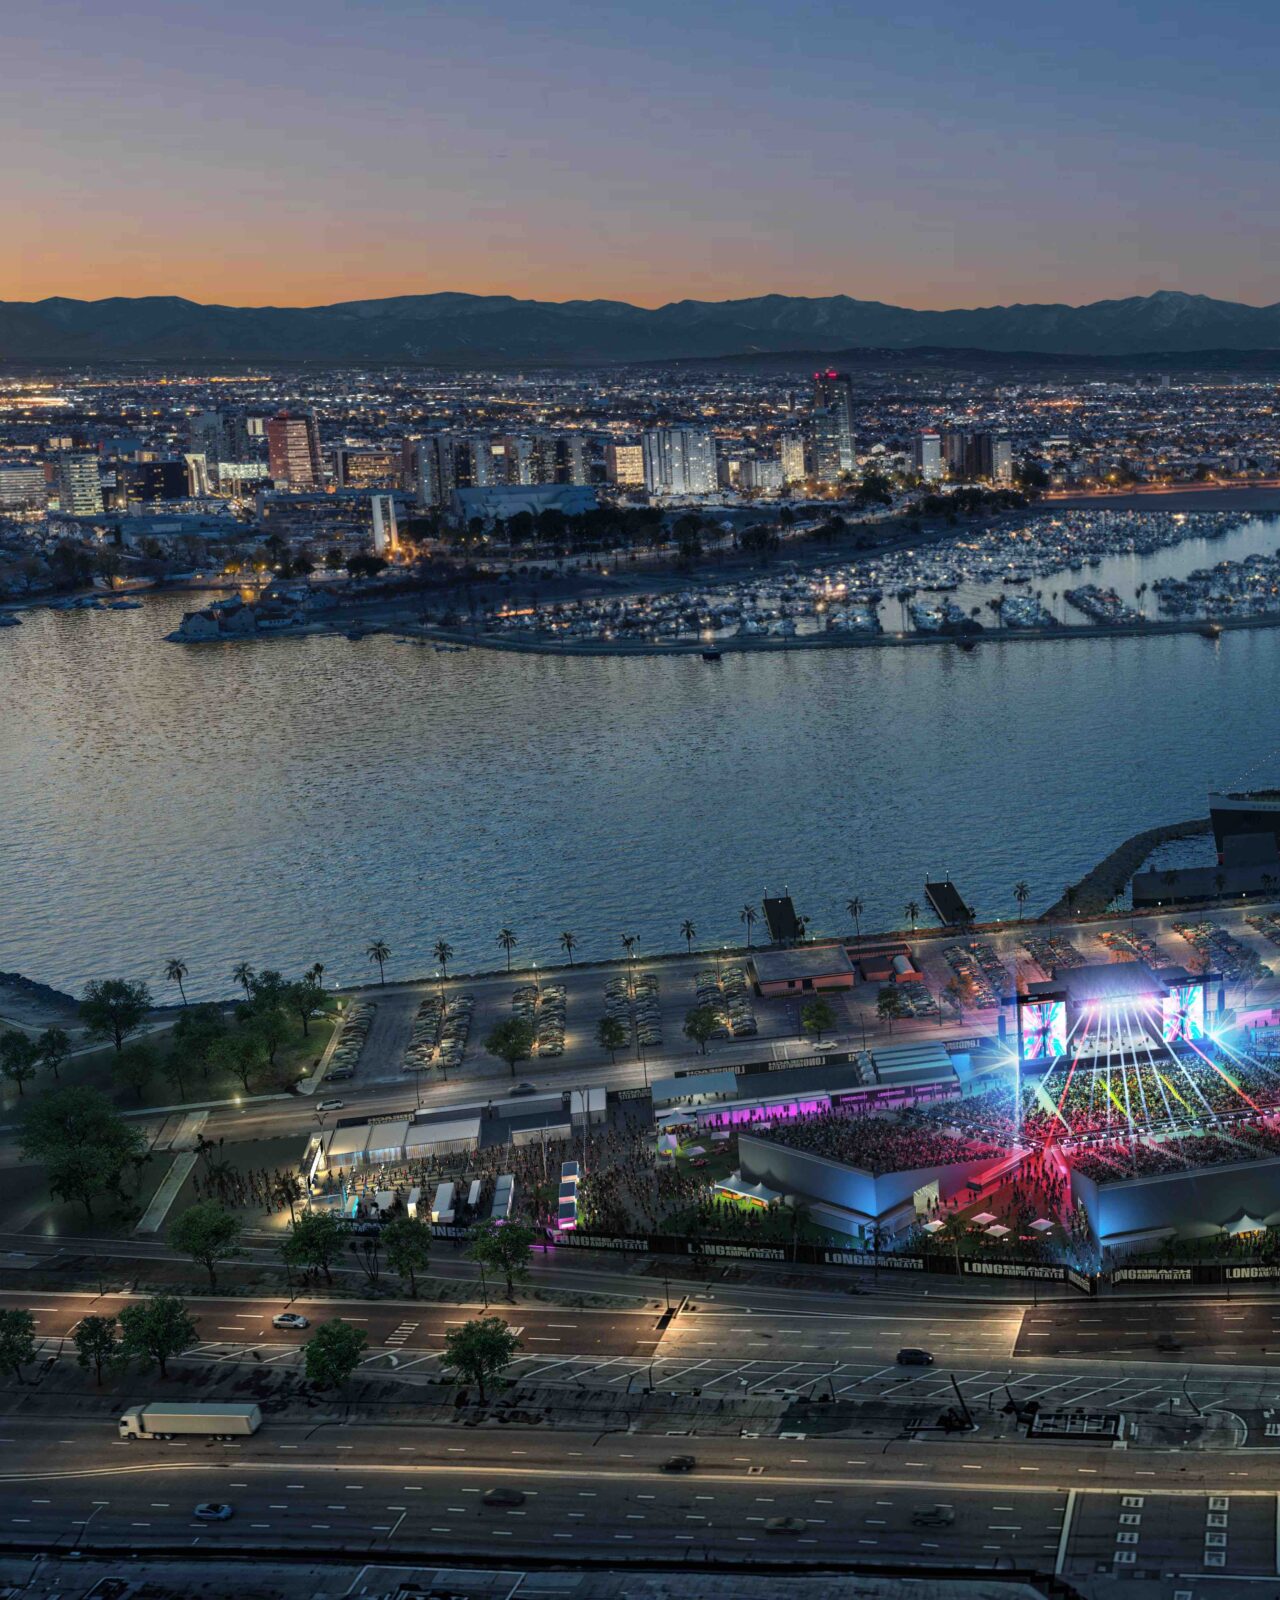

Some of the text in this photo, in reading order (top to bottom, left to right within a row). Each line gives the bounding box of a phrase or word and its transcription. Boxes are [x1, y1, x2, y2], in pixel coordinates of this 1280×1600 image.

[824, 1252, 863, 1265] LONG
[963, 1262, 1003, 1274] LONG
[1225, 1267, 1258, 1279] LONG
